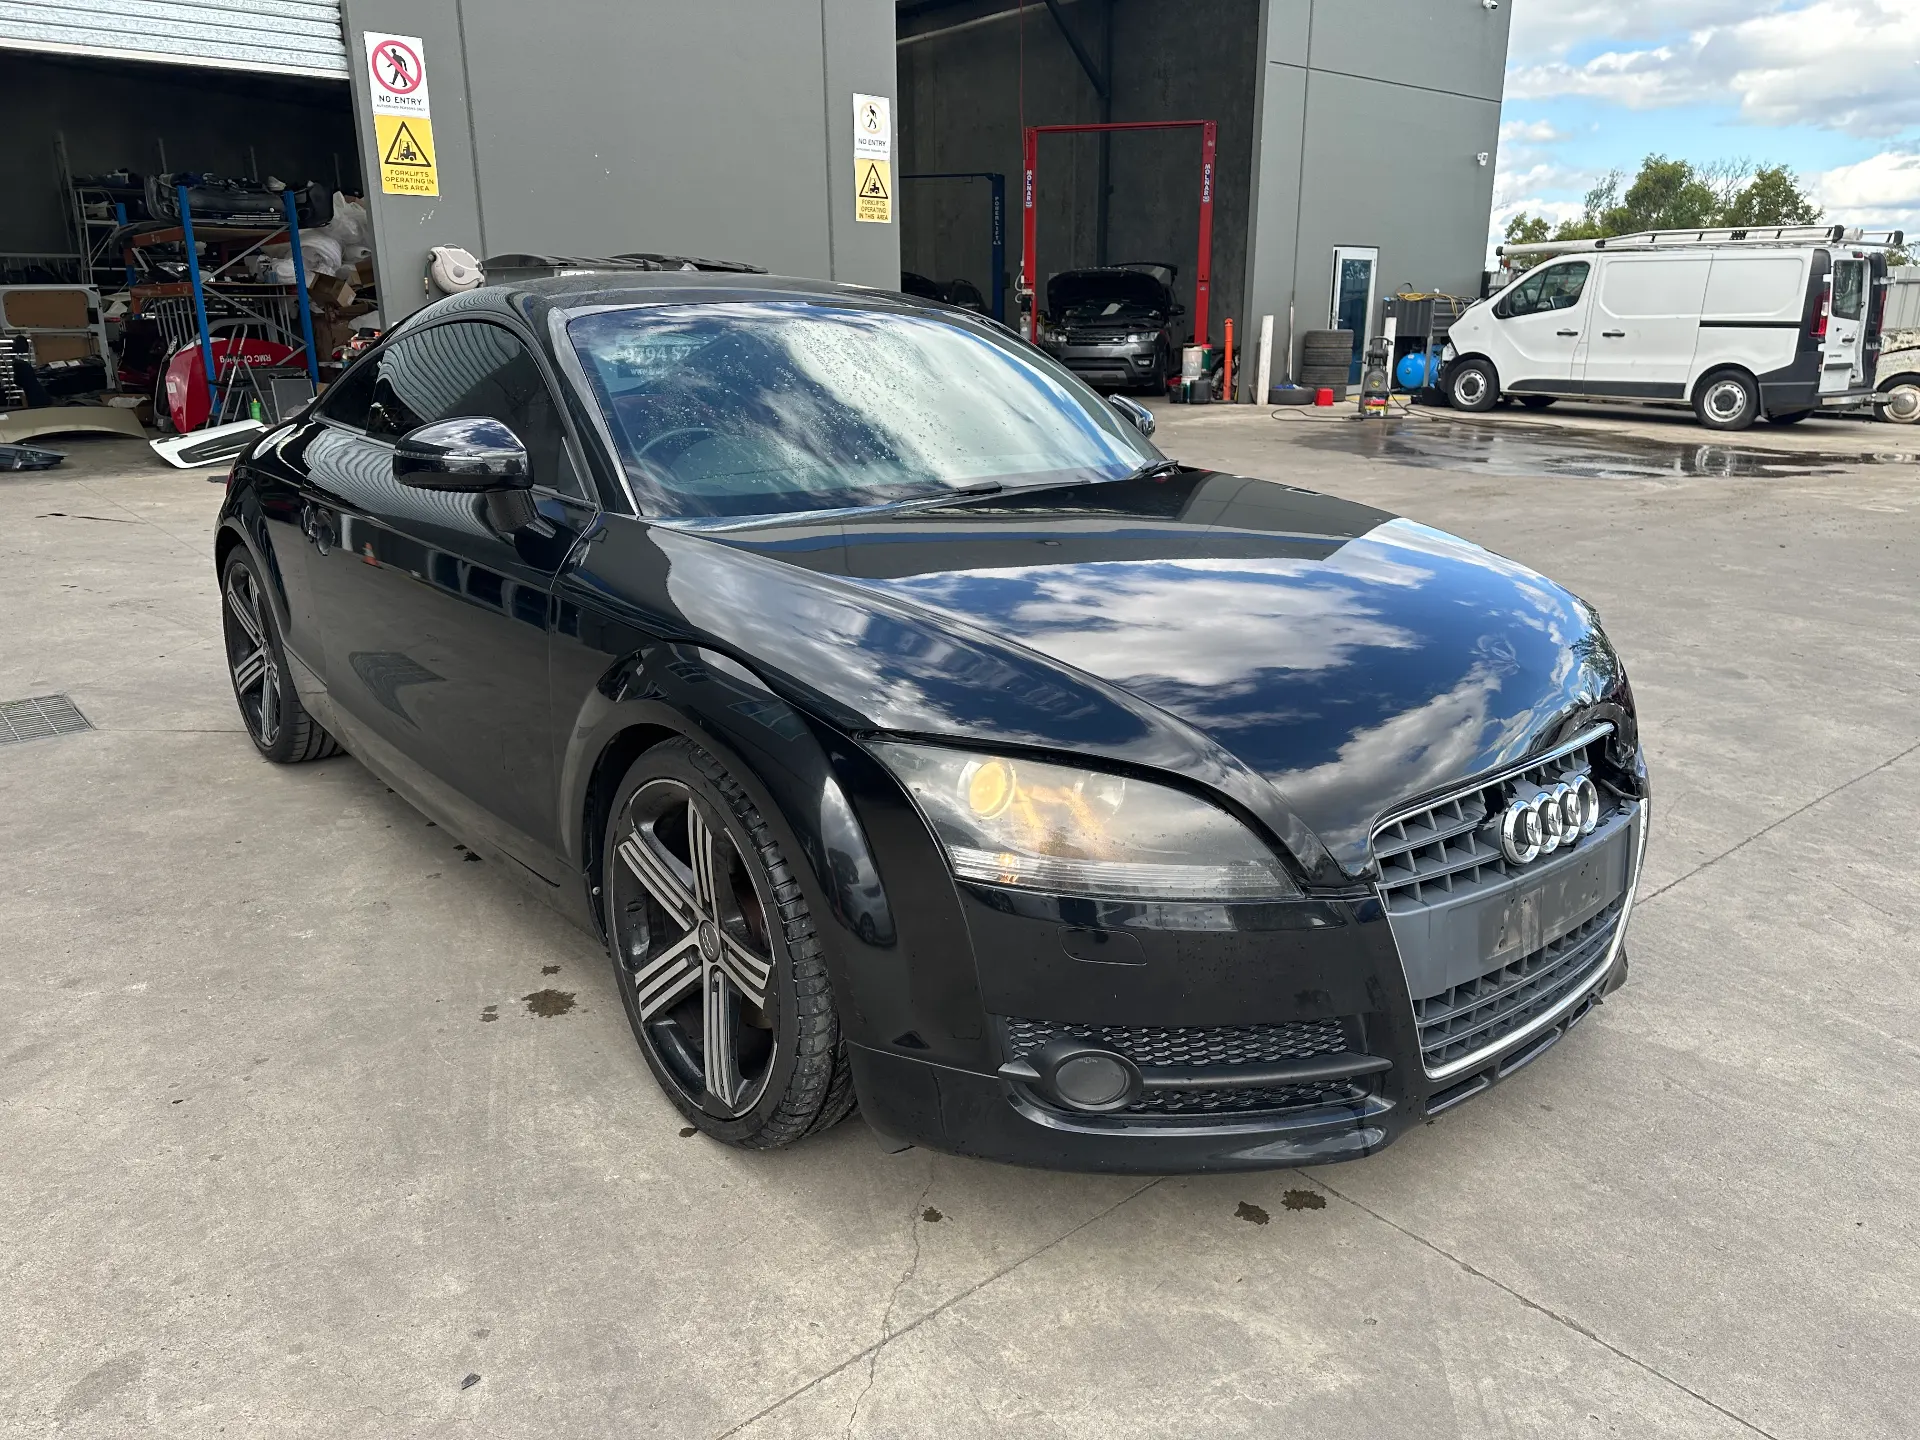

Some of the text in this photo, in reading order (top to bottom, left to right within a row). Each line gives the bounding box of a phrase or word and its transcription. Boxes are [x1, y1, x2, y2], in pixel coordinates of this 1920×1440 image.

[379, 95, 422, 105] NO ENTRY
[390, 170, 429, 178] FORKLIFTS
[385, 176, 425, 184] OPERATING
[1203, 163, 1211, 196] MOLNAR
[254, 354, 272, 362] RMC
